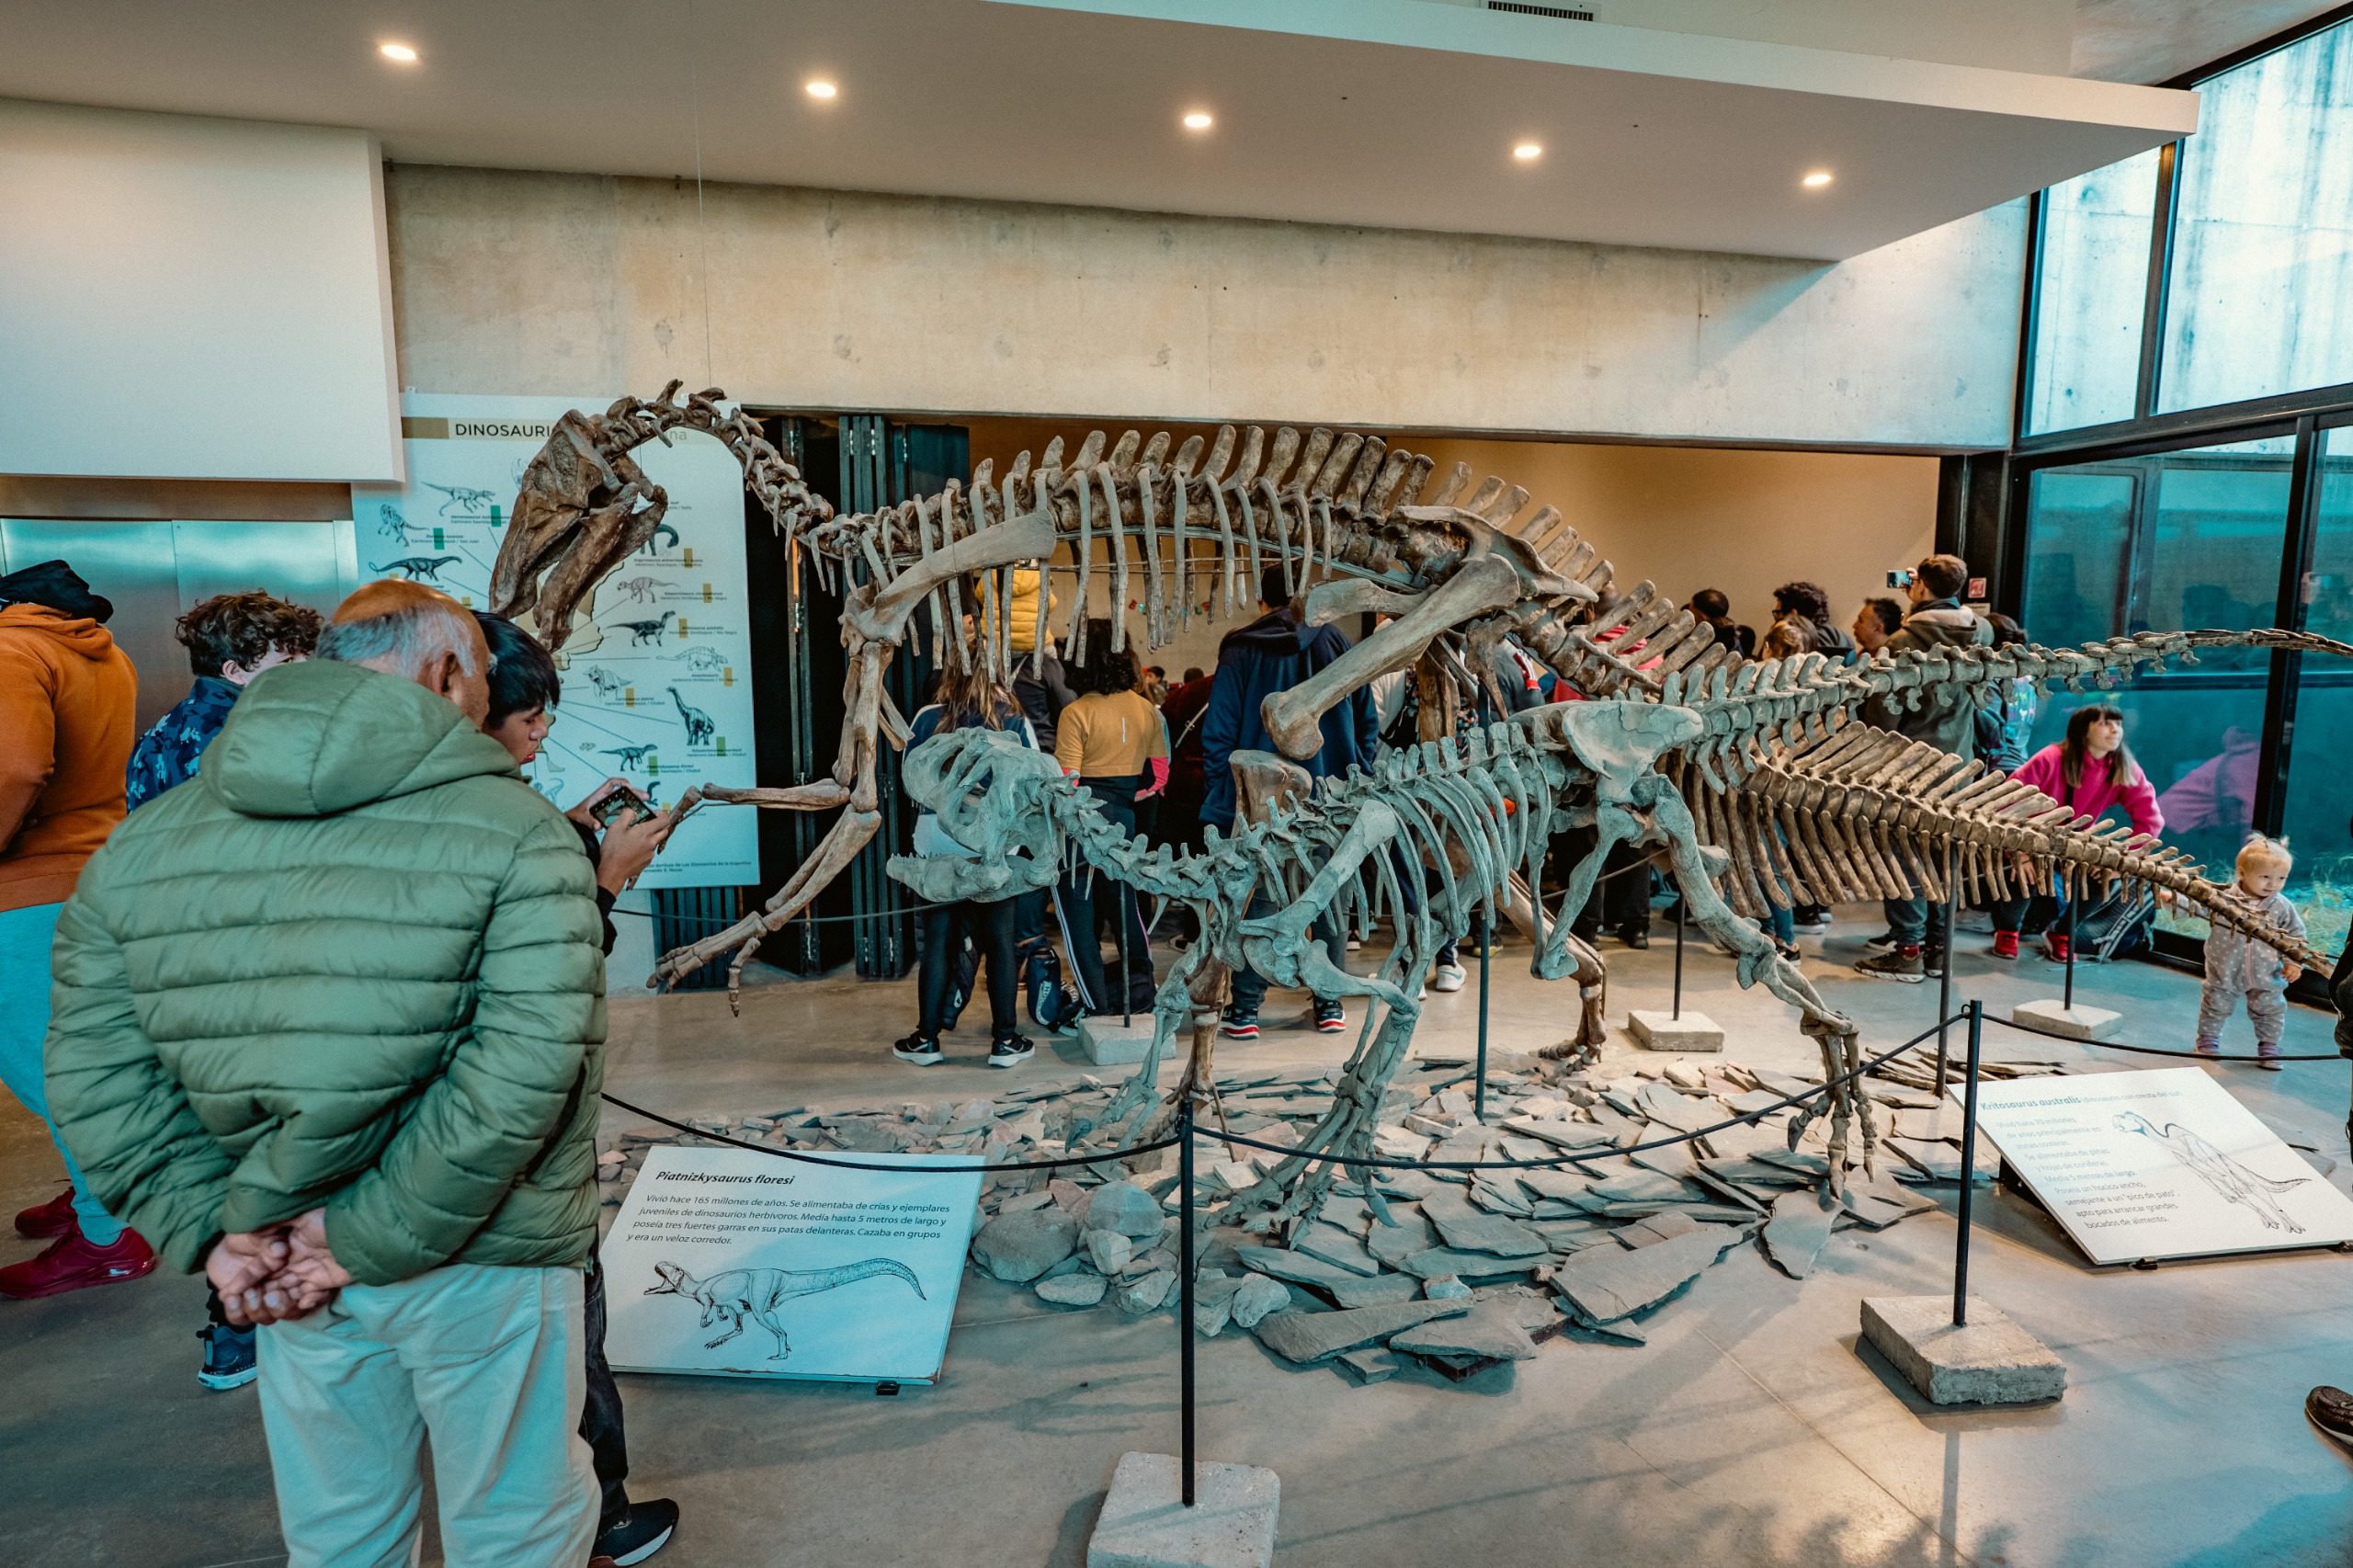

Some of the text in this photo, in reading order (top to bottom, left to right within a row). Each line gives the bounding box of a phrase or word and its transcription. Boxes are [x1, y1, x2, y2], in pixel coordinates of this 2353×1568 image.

[455, 423, 551, 437] DINOSAURI
[1980, 1098, 2039, 1111] Kritosaurus
[2040, 1096, 2082, 1107] australis
[655, 1171, 796, 1186] Piatnizkysaurus floresi
[646, 1194, 950, 1214] Vivió hace 165 millones de años. Se alimentaba de crías y ejemplares
[2065, 1197, 2105, 1206] semejante
[639, 1207, 947, 1228] juveniles de dinosaurios herbívoros. Medía hasta 5 metros de largo y
[2075, 1203, 2178, 1219] apto para arrancar grandes
[632, 1220, 664, 1229] poseía
[665, 1221, 682, 1230] tres
[683, 1221, 716, 1232] fuertes
[717, 1223, 746, 1233] garras
[778, 1225, 803, 1235] patas
[805, 1226, 856, 1236] delanteras.
[857, 1228, 892, 1237] Cazaba
[906, 1230, 941, 1240] grupos
[2084, 1219, 2120, 1229] bocados
[651, 1234, 664, 1243] un
[665, 1234, 689, 1244] veloz
[690, 1235, 733, 1244] corredor.
